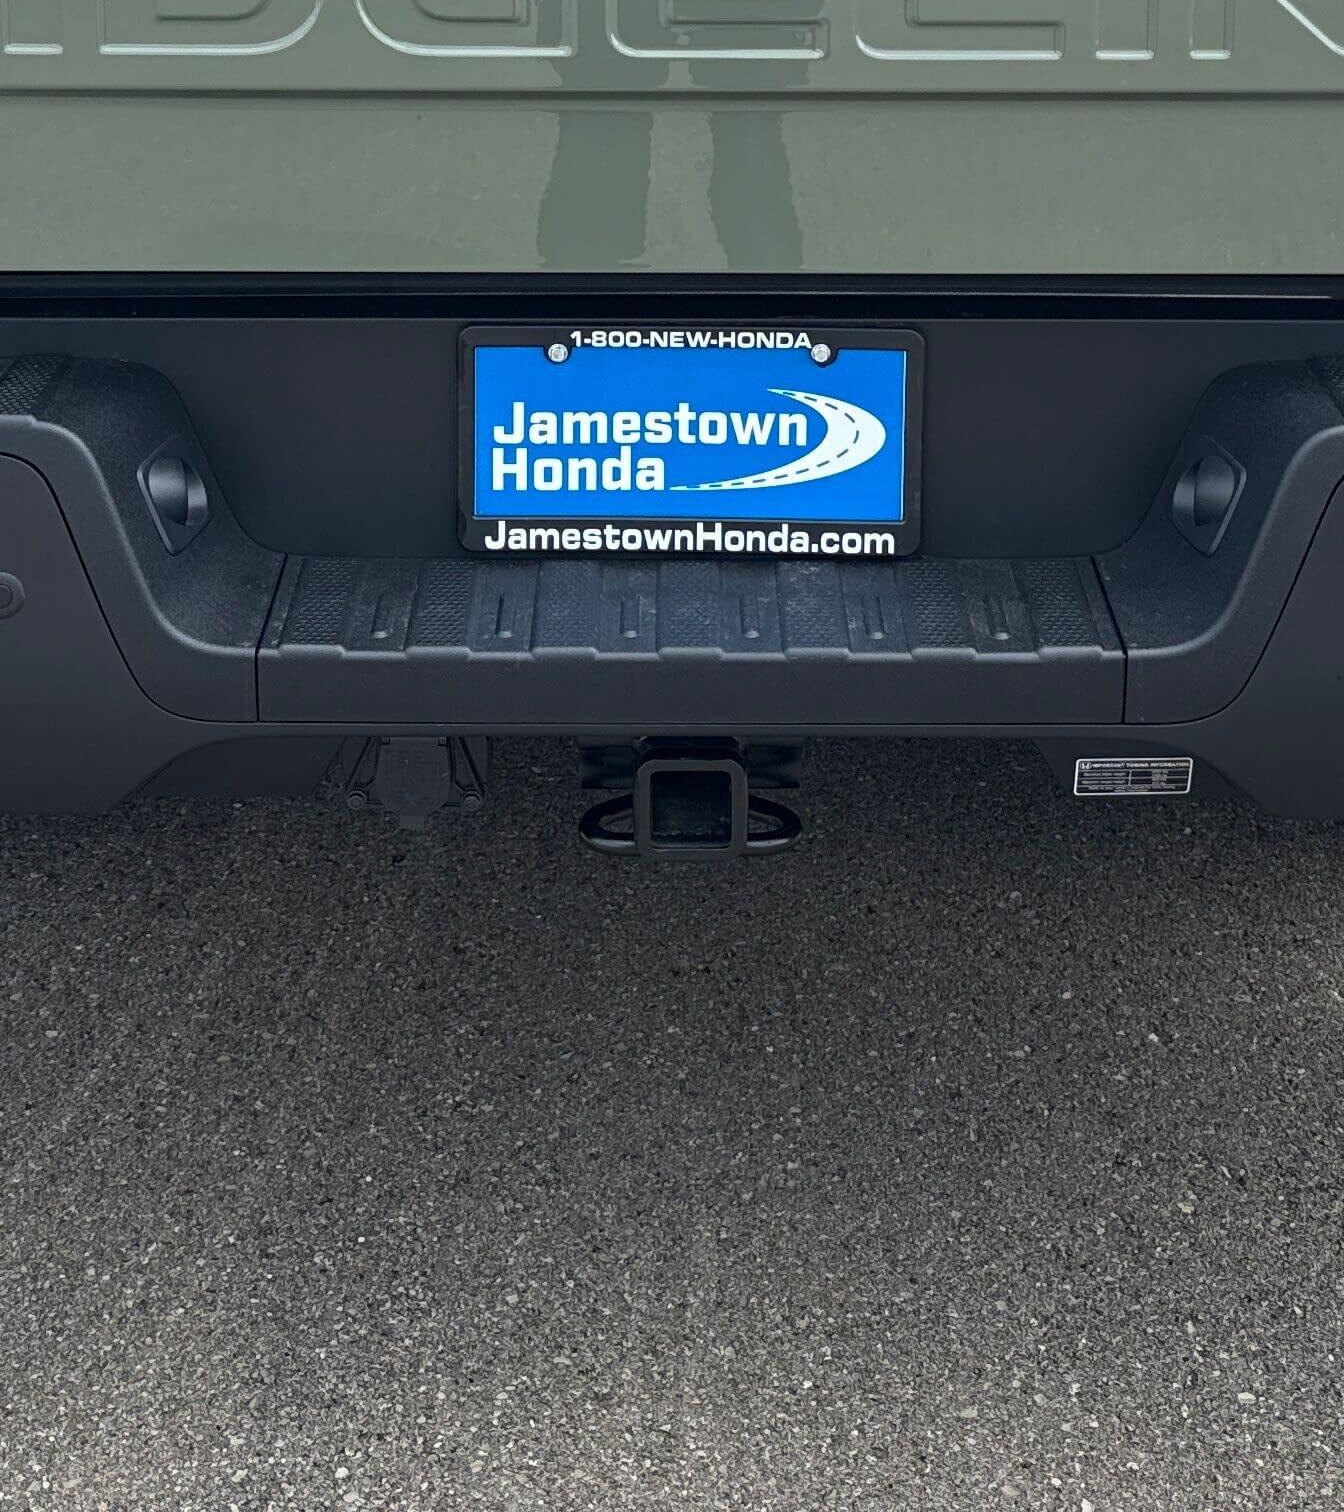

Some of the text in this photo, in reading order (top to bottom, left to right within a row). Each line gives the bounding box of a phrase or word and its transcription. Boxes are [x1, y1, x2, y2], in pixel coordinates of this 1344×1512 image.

[570, 330, 811, 350] 1-800-NEW-HONDA
[492, 401, 808, 447] Jamestown
[491, 445, 666, 491] Honda
[484, 520, 896, 555] JamestownHonda.com
